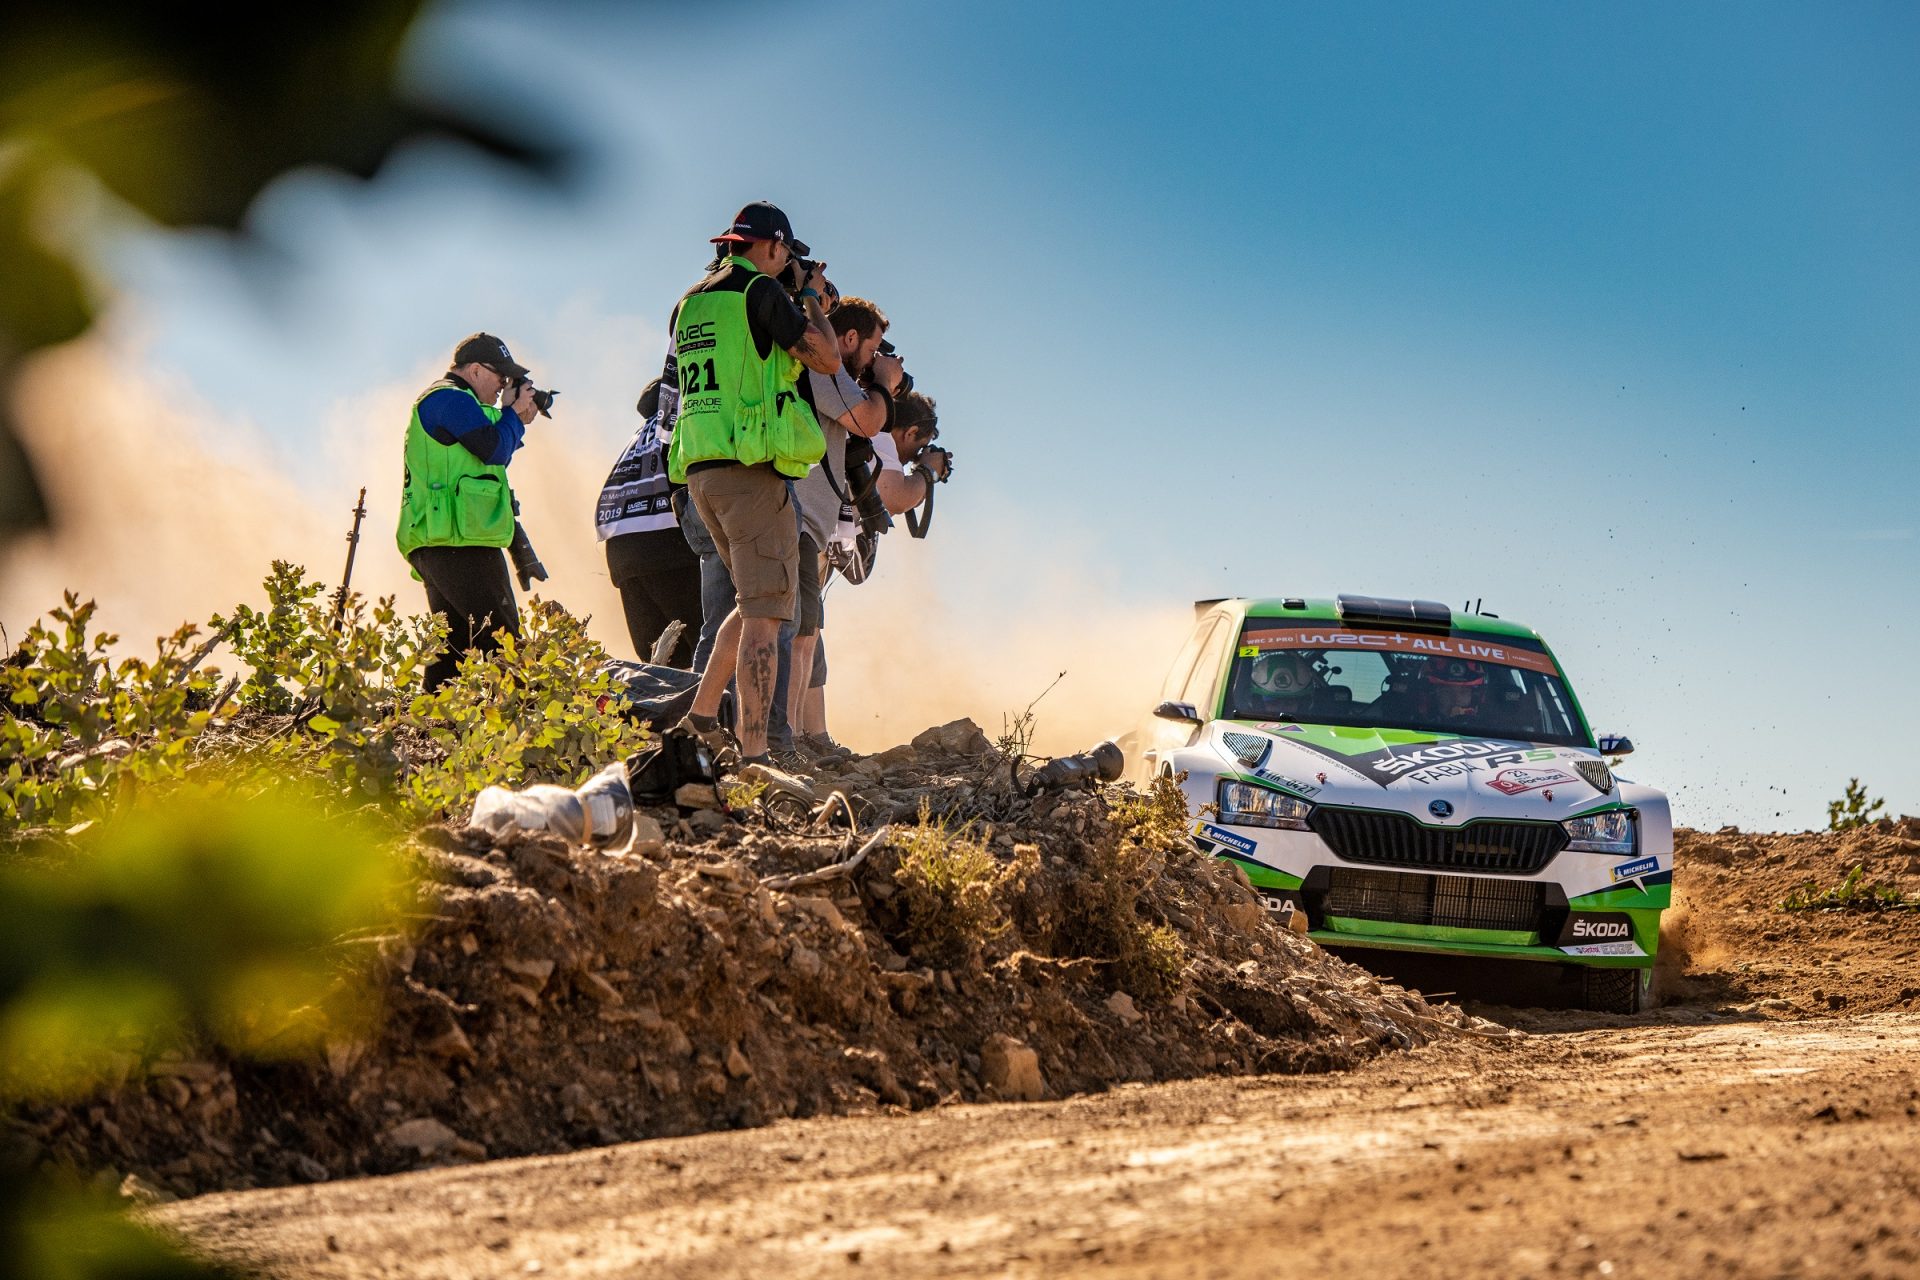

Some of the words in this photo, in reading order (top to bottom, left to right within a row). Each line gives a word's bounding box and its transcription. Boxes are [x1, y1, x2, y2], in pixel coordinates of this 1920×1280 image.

[676, 321, 715, 343] WRC
[681, 358, 719, 397] 021
[627, 500, 648, 510] WRC
[656, 499, 668, 508] FIA
[598, 507, 622, 520] 2019
[1412, 639, 1453, 652] ALL
[1457, 643, 1505, 660] LIVE
[1372, 740, 1521, 775] ŠKODA
[1408, 758, 1485, 785] FABIA
[1212, 832, 1252, 850] MICHELIN
[1623, 861, 1654, 876] MICHELIN
[1572, 919, 1629, 937] ŠKODA
